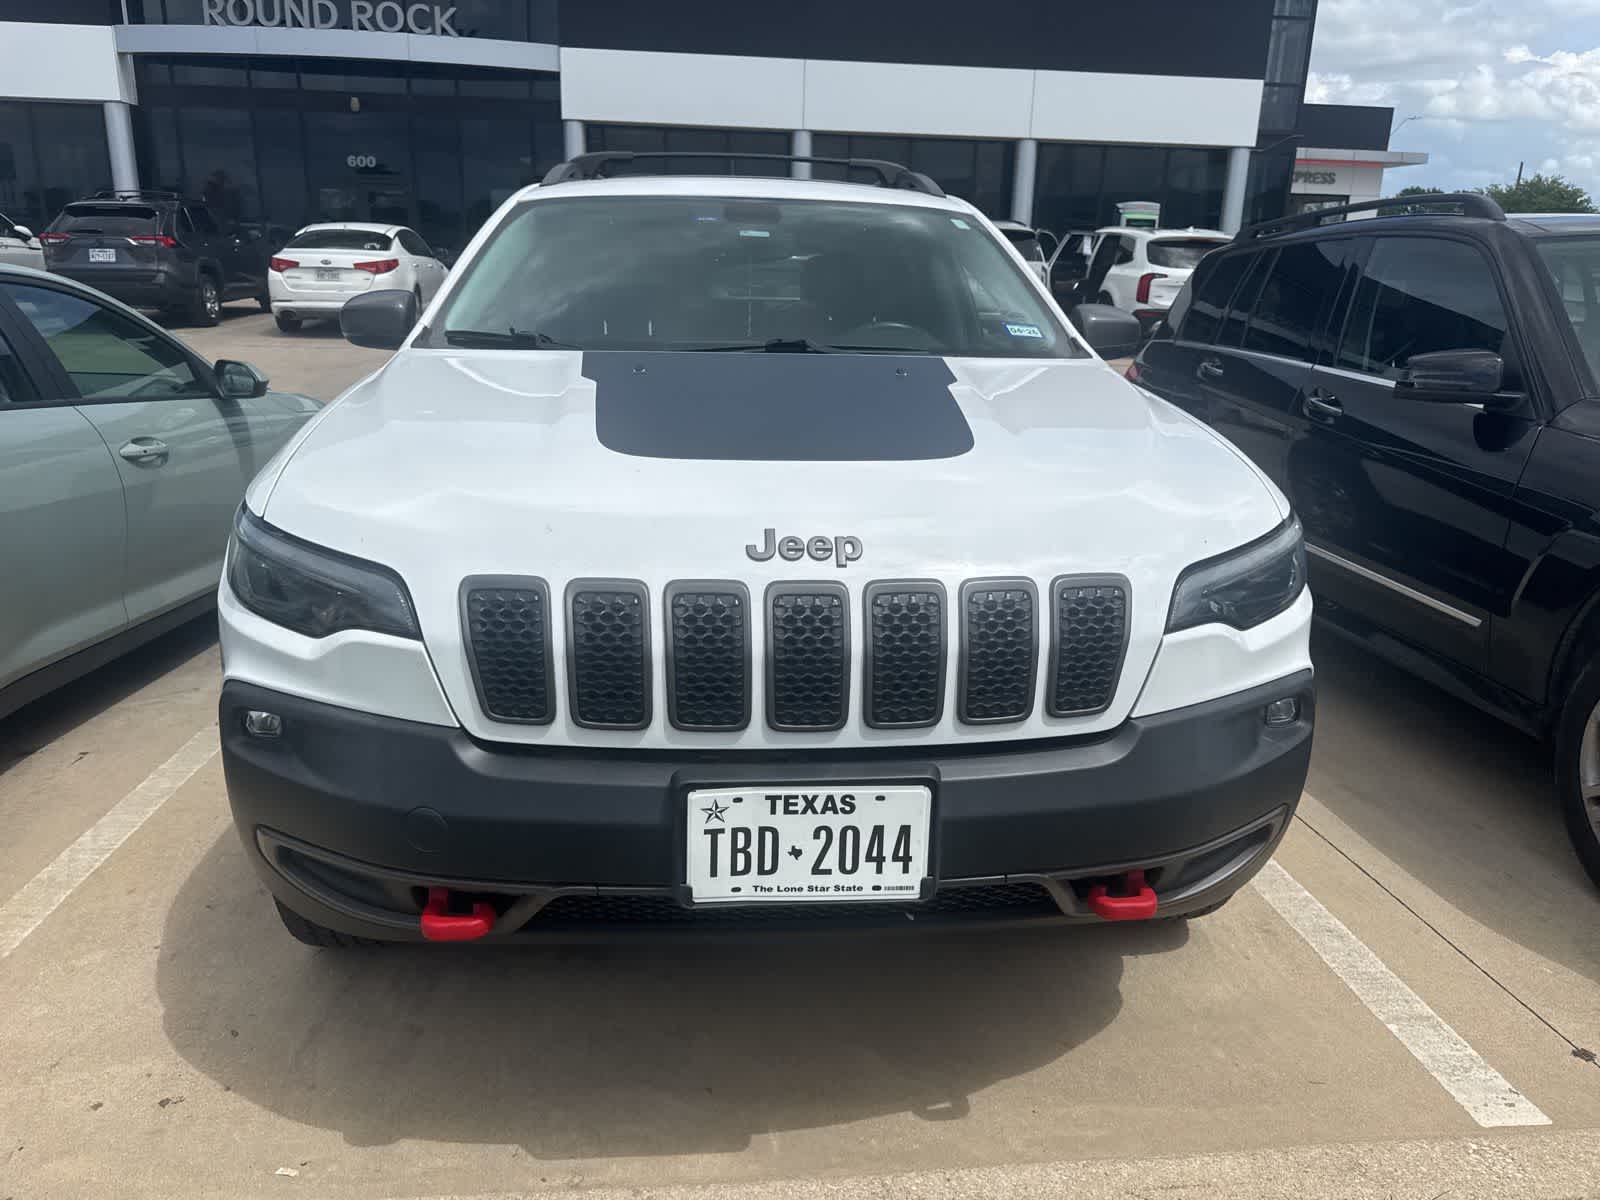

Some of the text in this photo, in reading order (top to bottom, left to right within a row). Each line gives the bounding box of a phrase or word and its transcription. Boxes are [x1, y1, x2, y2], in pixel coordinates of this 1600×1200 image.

[203, 0, 459, 37] ROUND ROCK
[347, 154, 377, 168] 600
[745, 528, 863, 568] Jeep
[765, 794, 856, 815] TEXAS
[703, 824, 913, 878] TBD 2044
[752, 884, 864, 893] The Lone Star State
